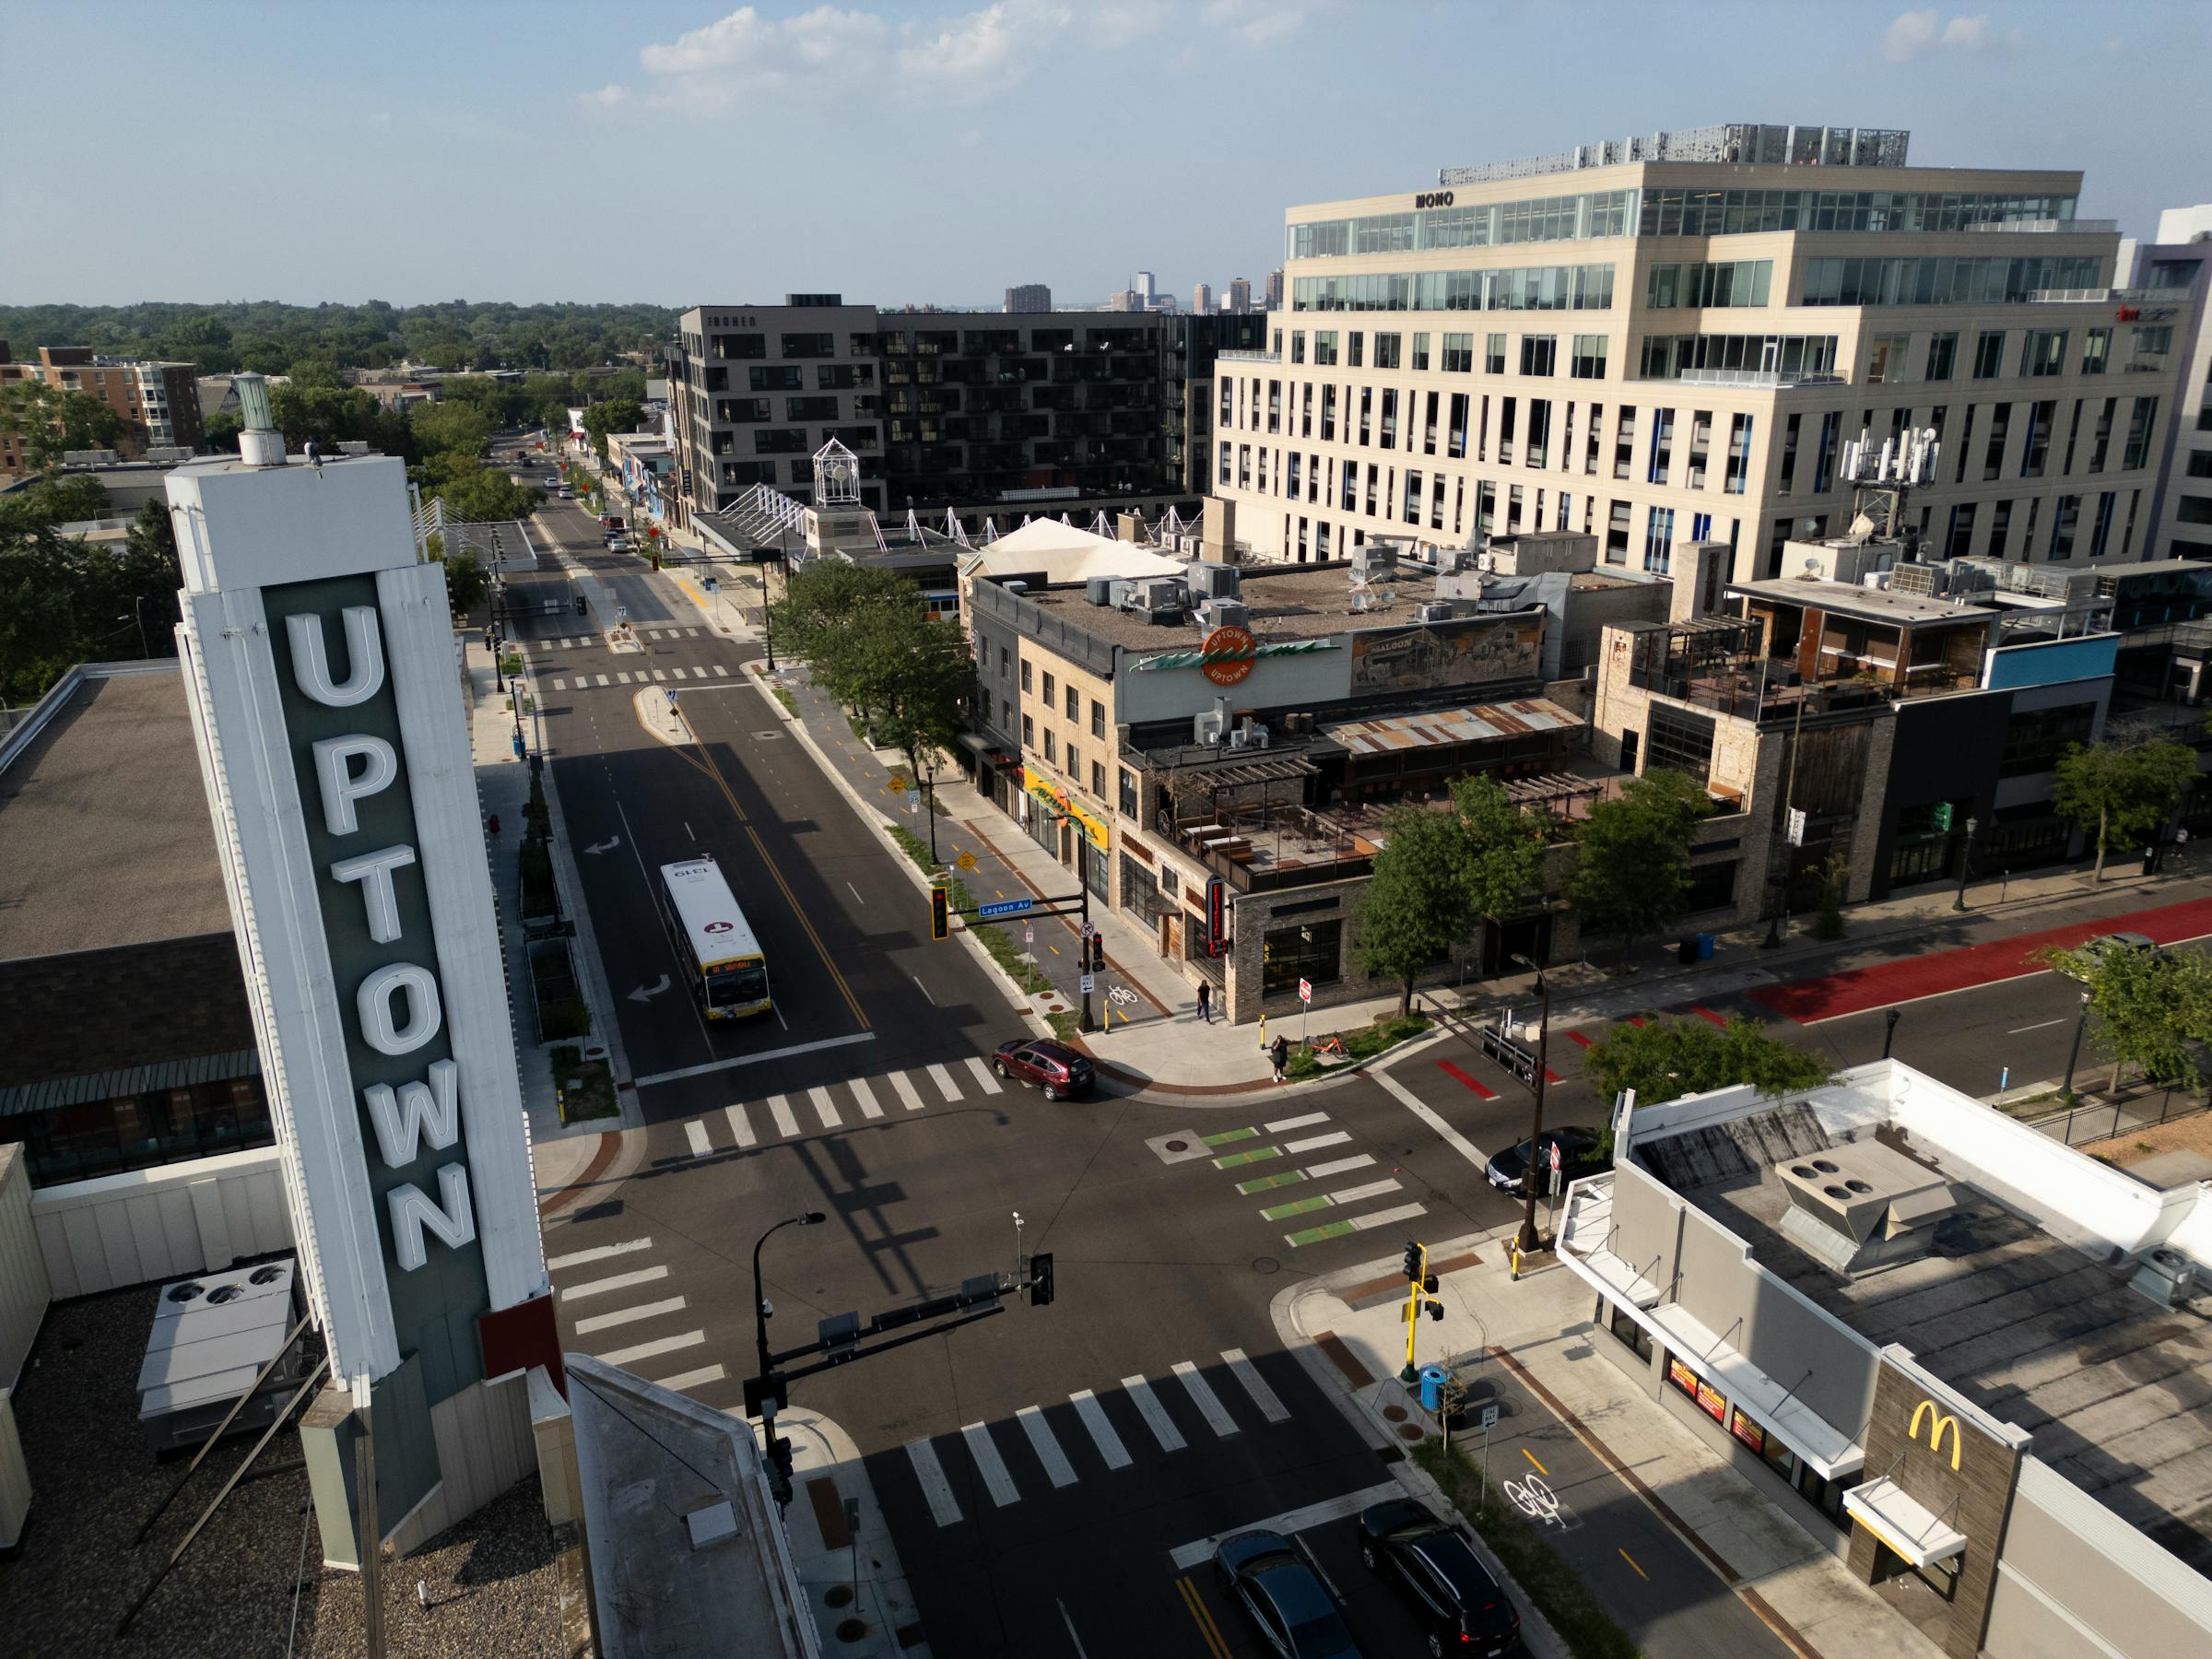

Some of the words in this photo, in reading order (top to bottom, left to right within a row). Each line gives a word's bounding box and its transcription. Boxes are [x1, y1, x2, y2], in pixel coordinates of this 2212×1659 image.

[1415, 191, 1454, 208] MONO
[1210, 629, 1249, 647] UPTOWN
[1210, 665, 1249, 683] UPTOWN
[982, 904, 1014, 915] Lagoon
[1018, 901, 1029, 910] Av
[285, 606, 477, 1272] UPTOWN
